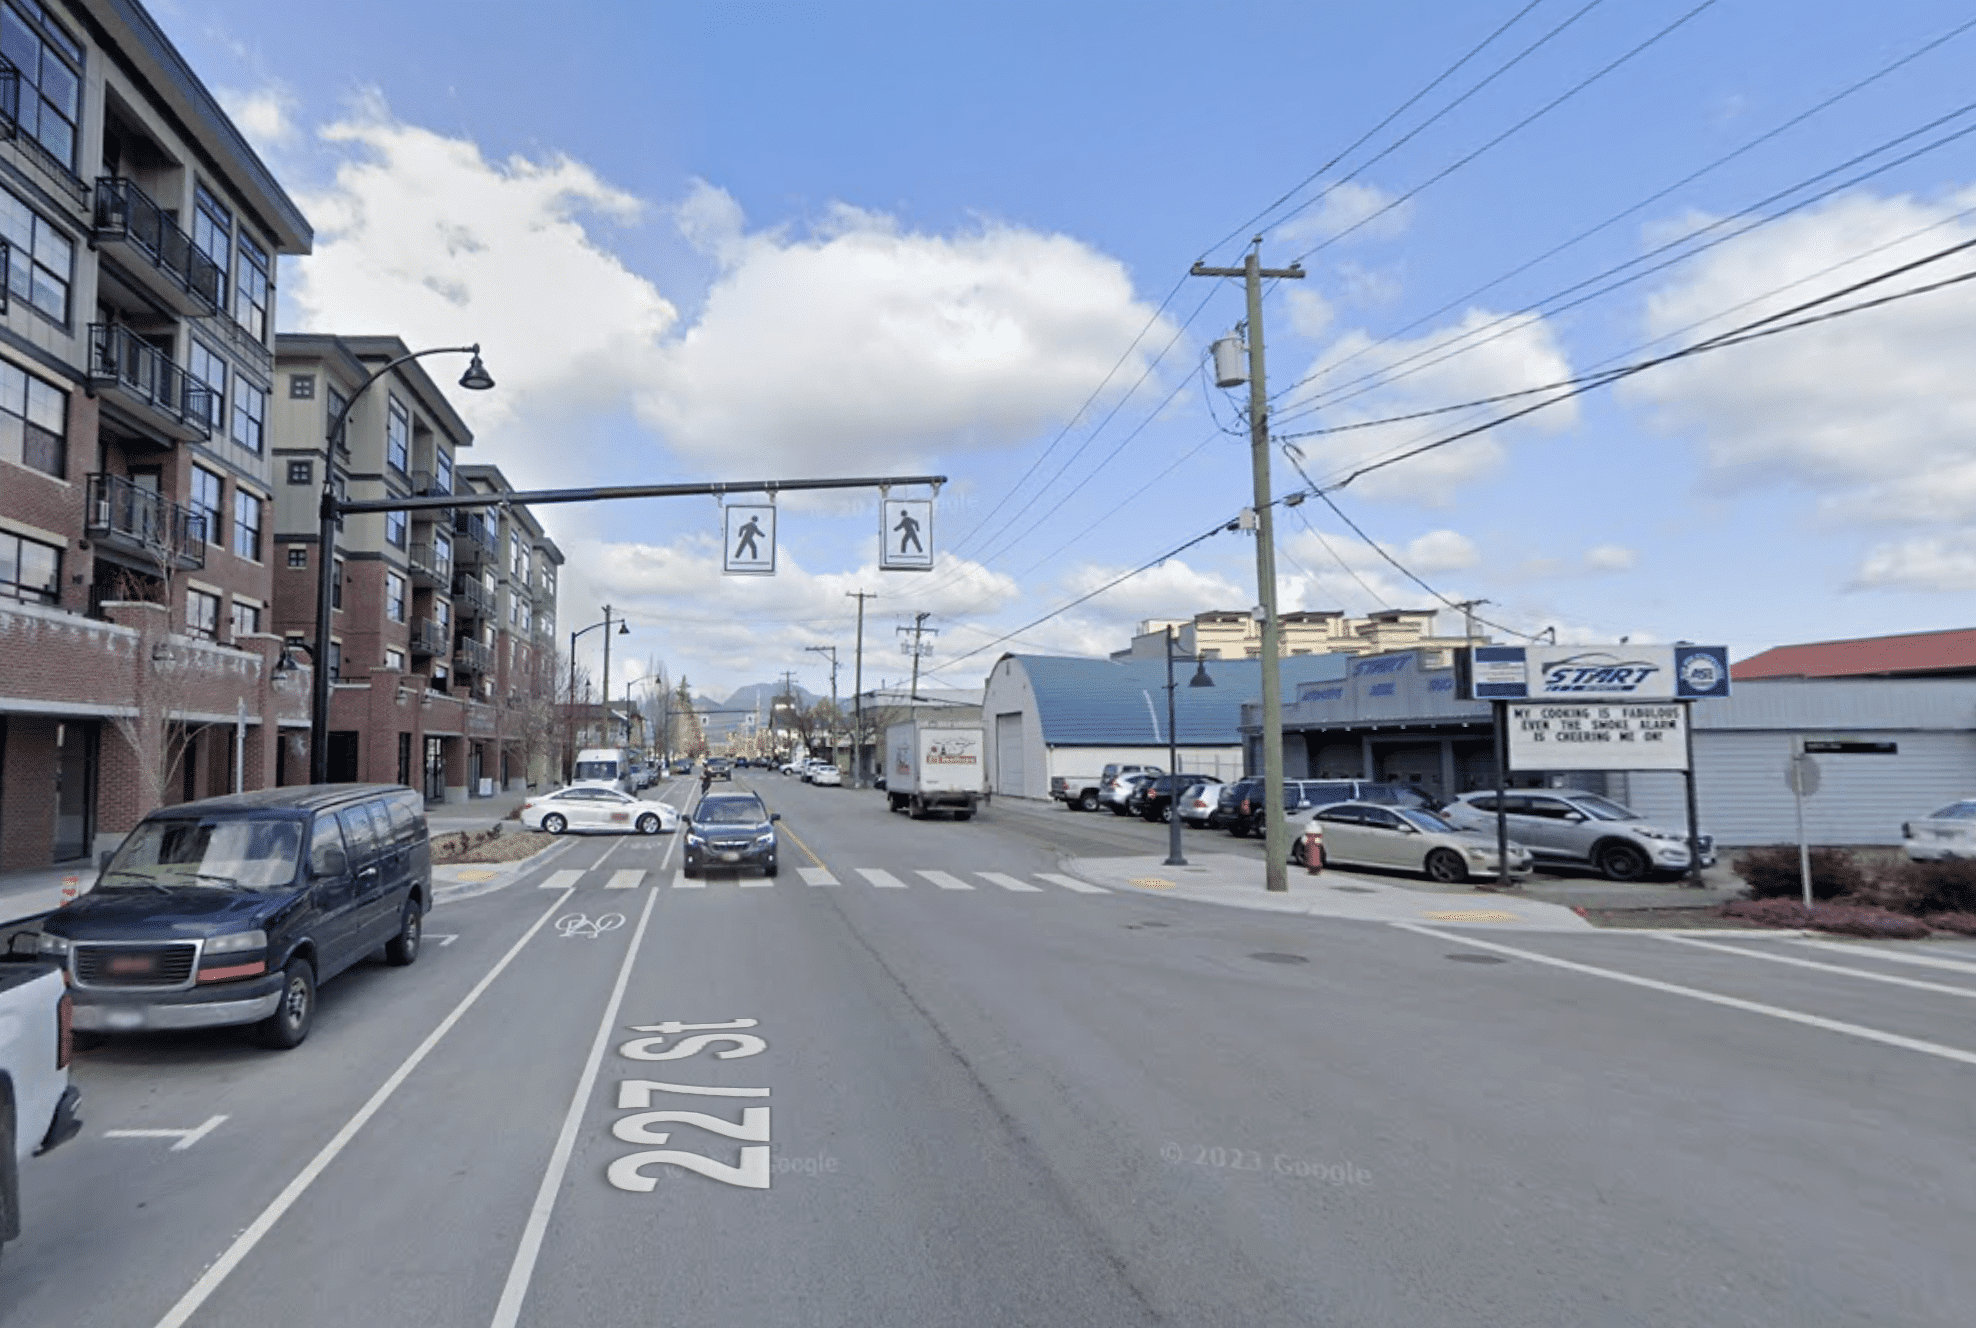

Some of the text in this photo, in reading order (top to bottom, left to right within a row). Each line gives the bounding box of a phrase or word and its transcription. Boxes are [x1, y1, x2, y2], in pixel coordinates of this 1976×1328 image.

[1545, 667, 1659, 684] START
[1514, 707, 1680, 719] MY COOKING IS FABULOUS
[1521, 719, 1677, 731] EVEN THE SMOKE ALARM
[1534, 731, 1545, 742] IS
[1556, 731, 1611, 742] CHEERING
[1619, 731, 1635, 742] ME
